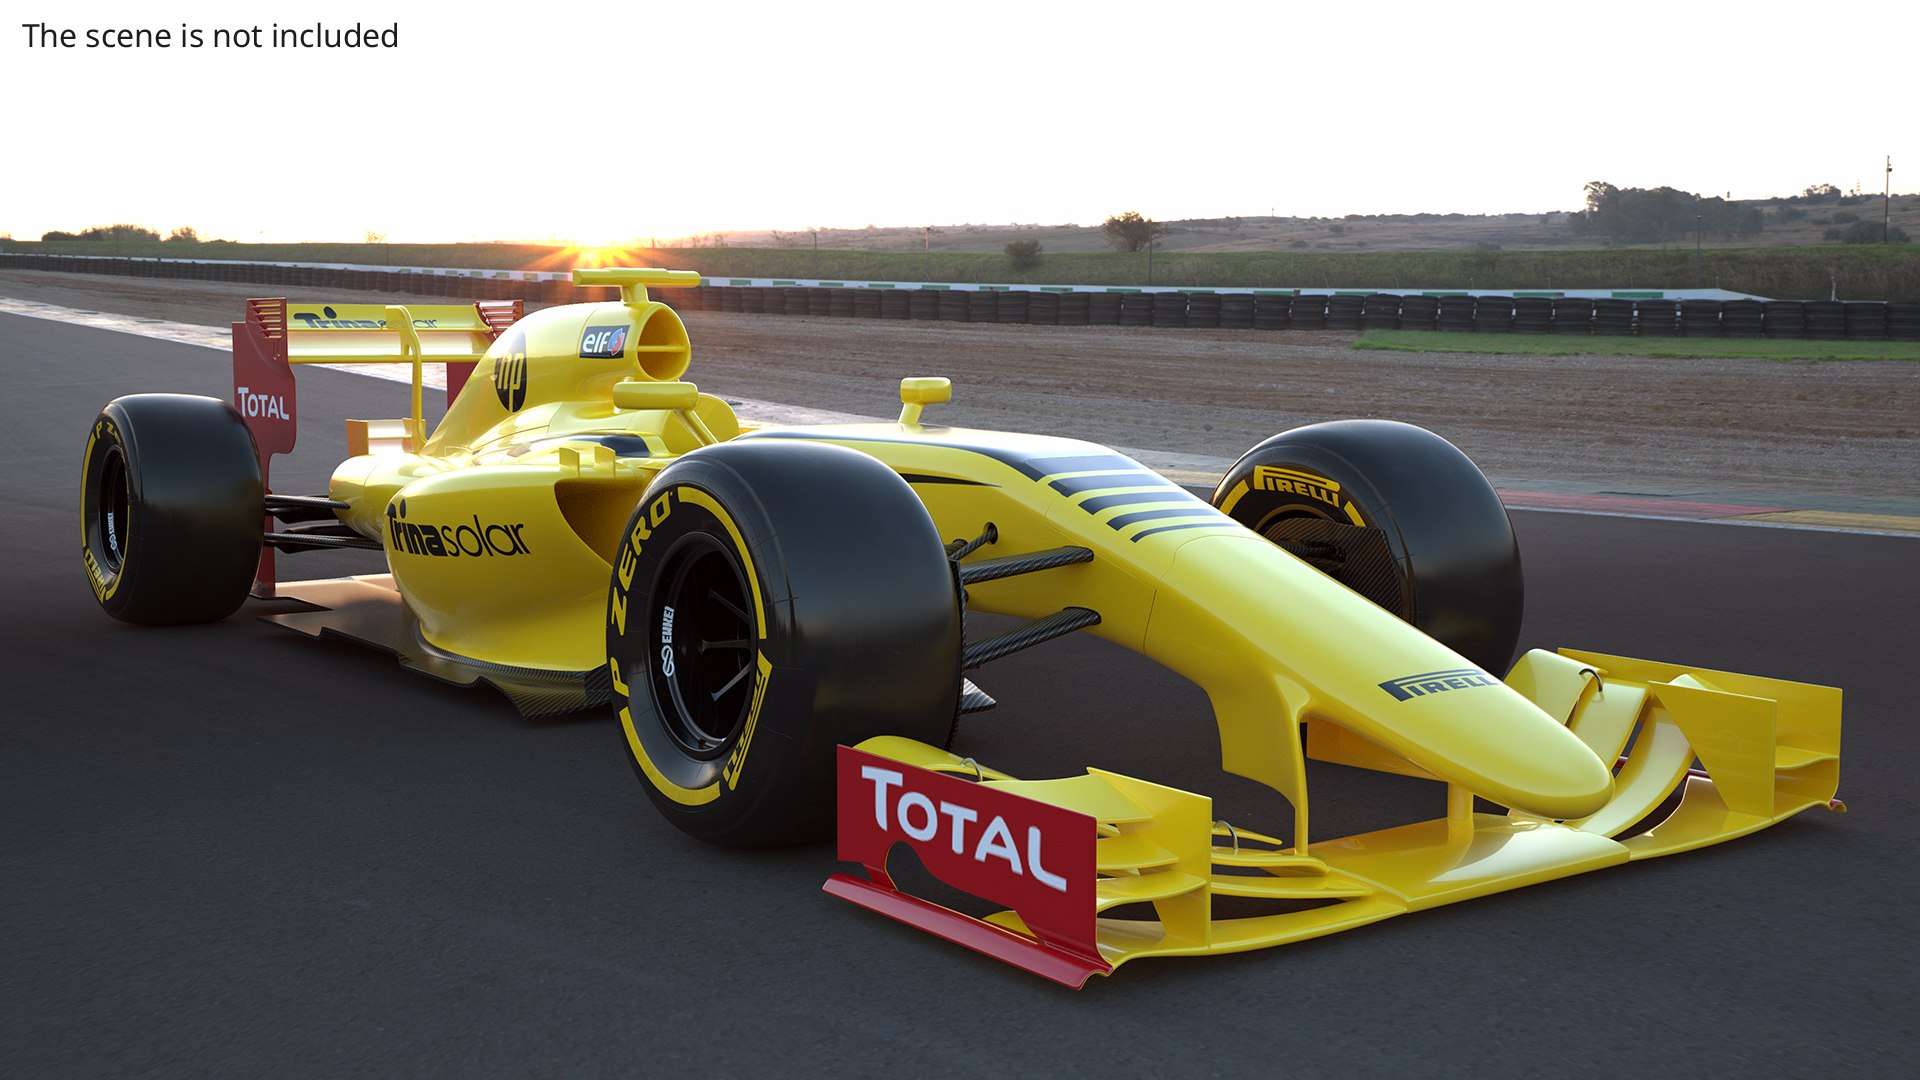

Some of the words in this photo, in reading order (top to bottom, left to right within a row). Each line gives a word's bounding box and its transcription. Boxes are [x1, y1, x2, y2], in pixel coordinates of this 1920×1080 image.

[582, 331, 612, 353] elf
[237, 386, 290, 421] TOTAL
[95, 420, 103, 440] P
[1253, 465, 1341, 509] PIRELLI
[610, 490, 671, 637] ZERO
[609, 655, 630, 698] P
[1377, 668, 1500, 702] PIRELL
[861, 765, 1067, 893] TOTAL
